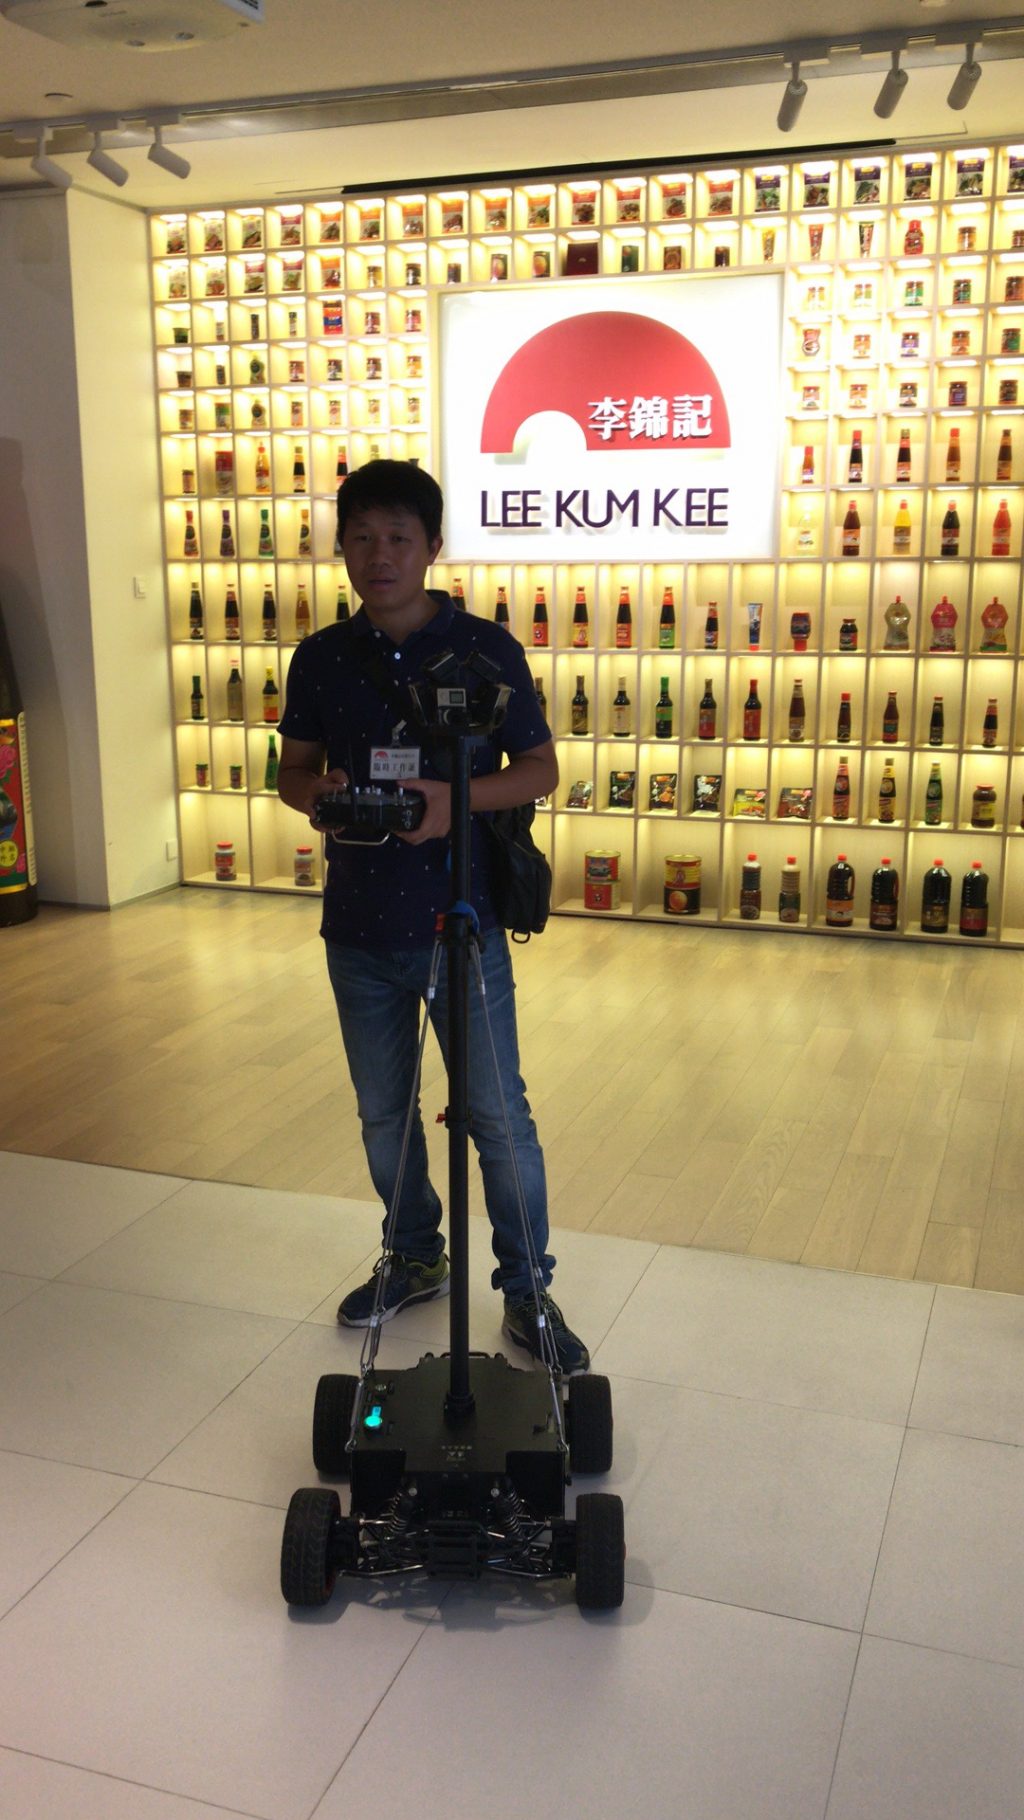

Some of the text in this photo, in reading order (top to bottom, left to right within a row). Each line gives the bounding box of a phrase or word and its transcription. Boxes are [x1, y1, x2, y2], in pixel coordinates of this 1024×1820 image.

[588, 394, 713, 440] 李錦記
[481, 487, 729, 528] LEE KUM KEE
